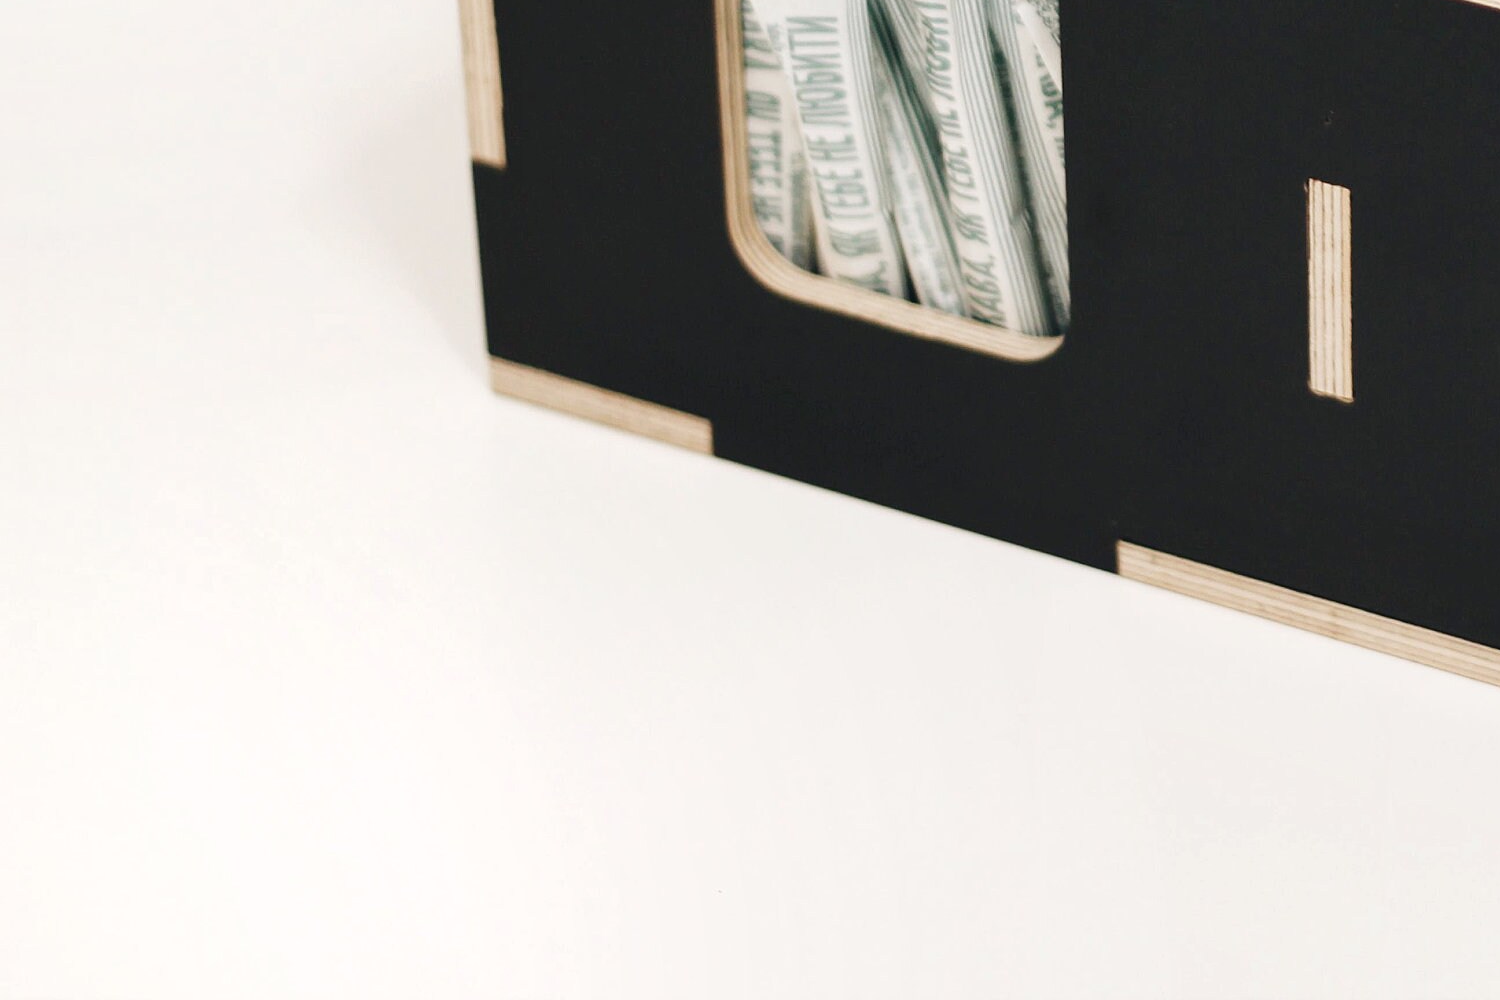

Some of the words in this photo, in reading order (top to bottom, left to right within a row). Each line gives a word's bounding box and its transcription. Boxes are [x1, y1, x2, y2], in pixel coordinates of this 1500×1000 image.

[785, 15, 852, 127] ЛЮБИТИ
[803, 133, 859, 162] НЕ
[813, 166, 875, 220] ТЕБЕ
[827, 224, 882, 258] ЯК
